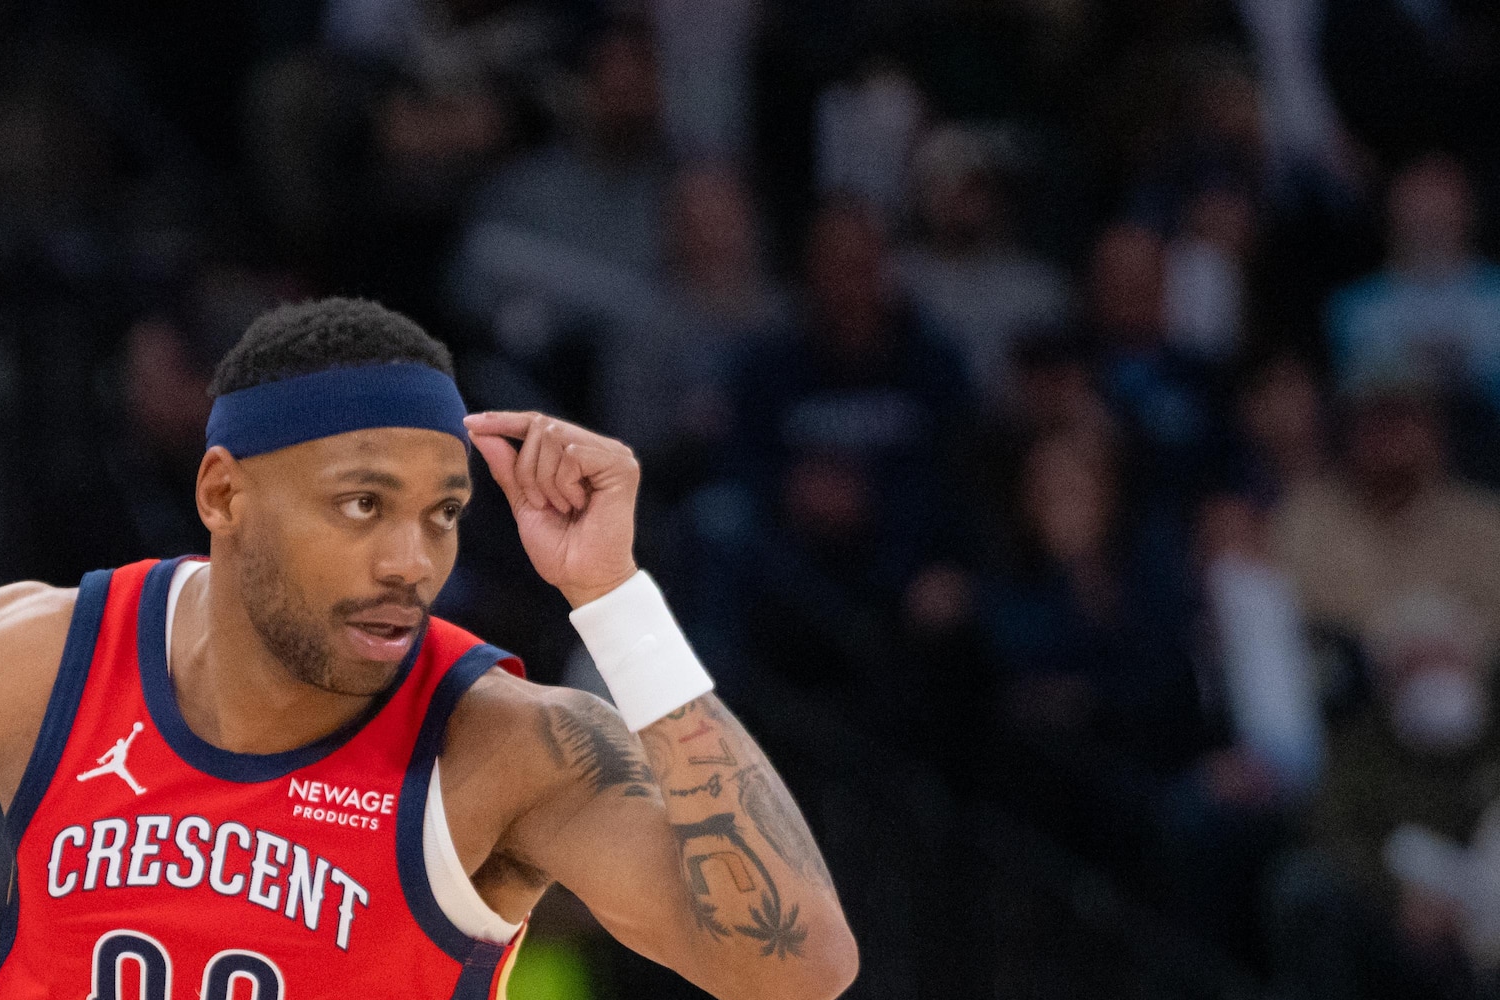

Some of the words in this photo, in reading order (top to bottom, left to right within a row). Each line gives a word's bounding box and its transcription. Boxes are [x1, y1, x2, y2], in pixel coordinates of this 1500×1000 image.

[288, 777, 395, 814] NEWAGE
[293, 805, 379, 830] PRODUCTS
[48, 815, 369, 950] CRESCENT
